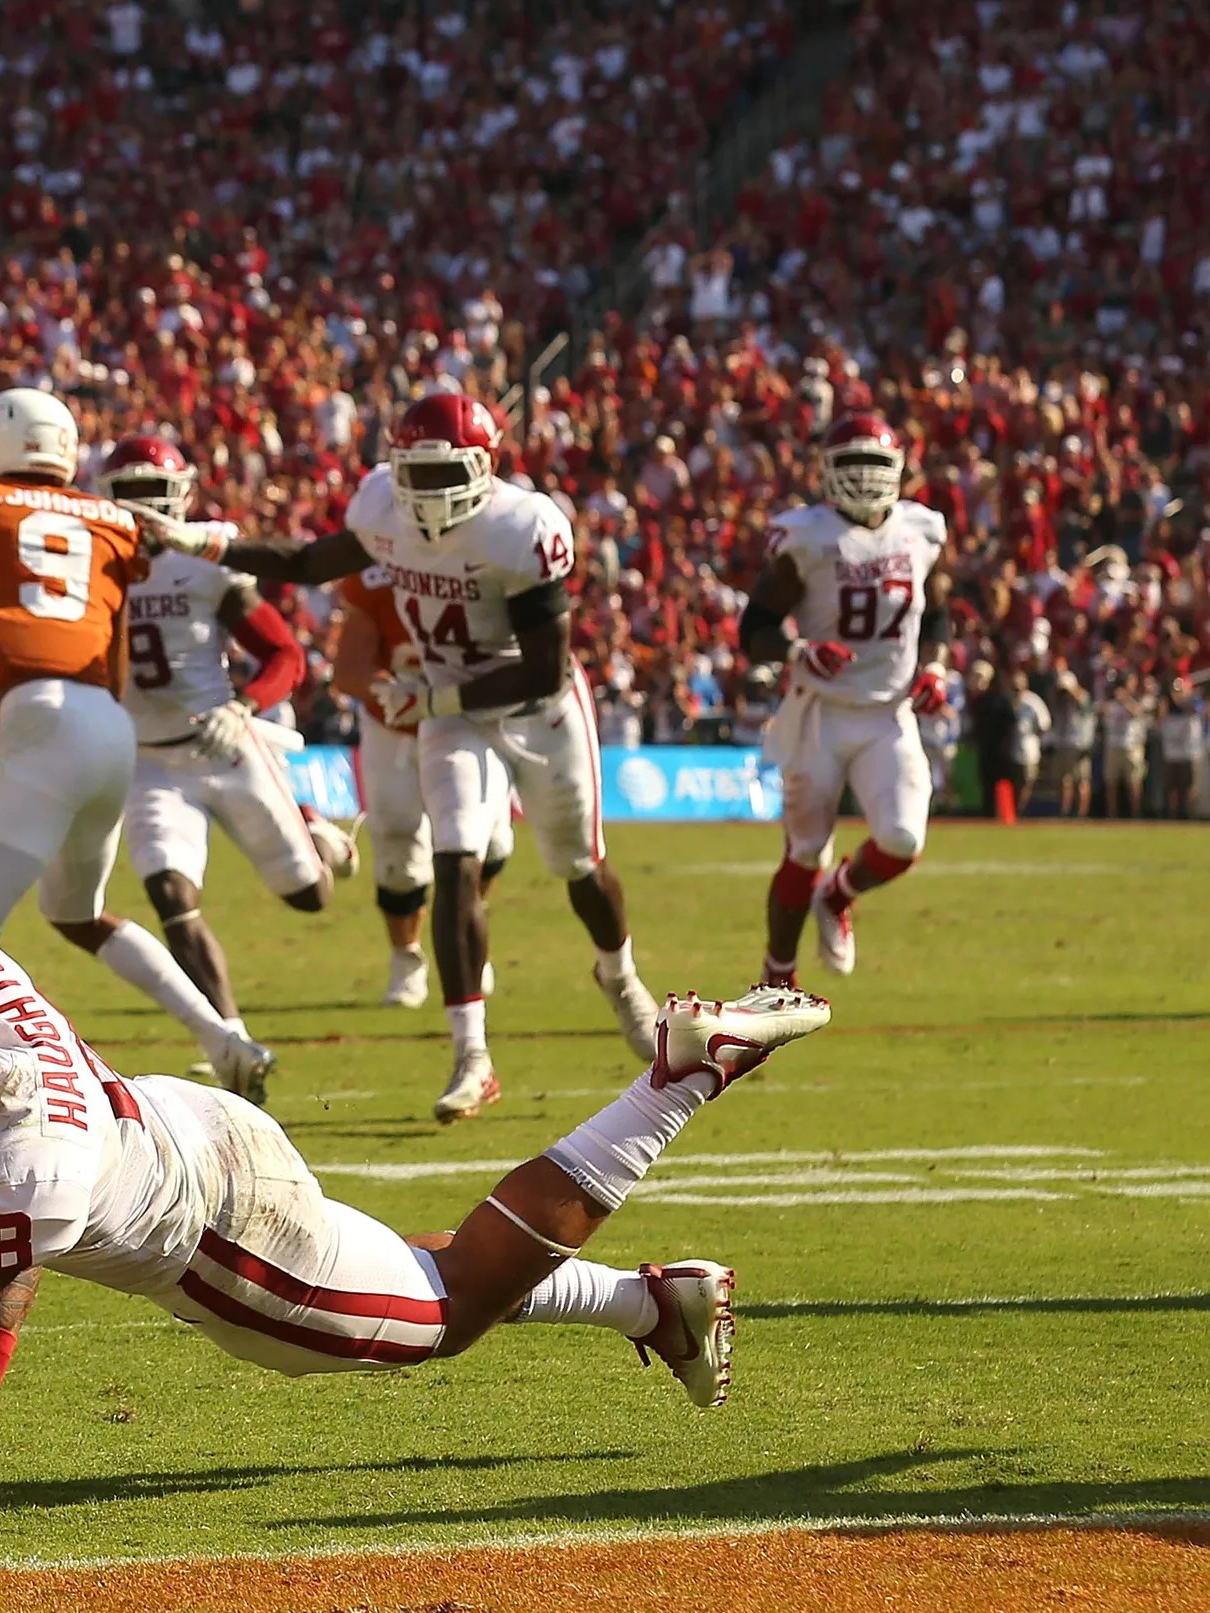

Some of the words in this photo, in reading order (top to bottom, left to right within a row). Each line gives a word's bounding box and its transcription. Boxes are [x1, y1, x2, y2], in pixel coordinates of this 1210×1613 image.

[18, 511, 93, 622] 9
[534, 534, 568, 579] 14
[129, 594, 189, 618] NERS
[406, 597, 493, 665] 14
[838, 579, 913, 640] 87
[128, 623, 172, 689] 9
